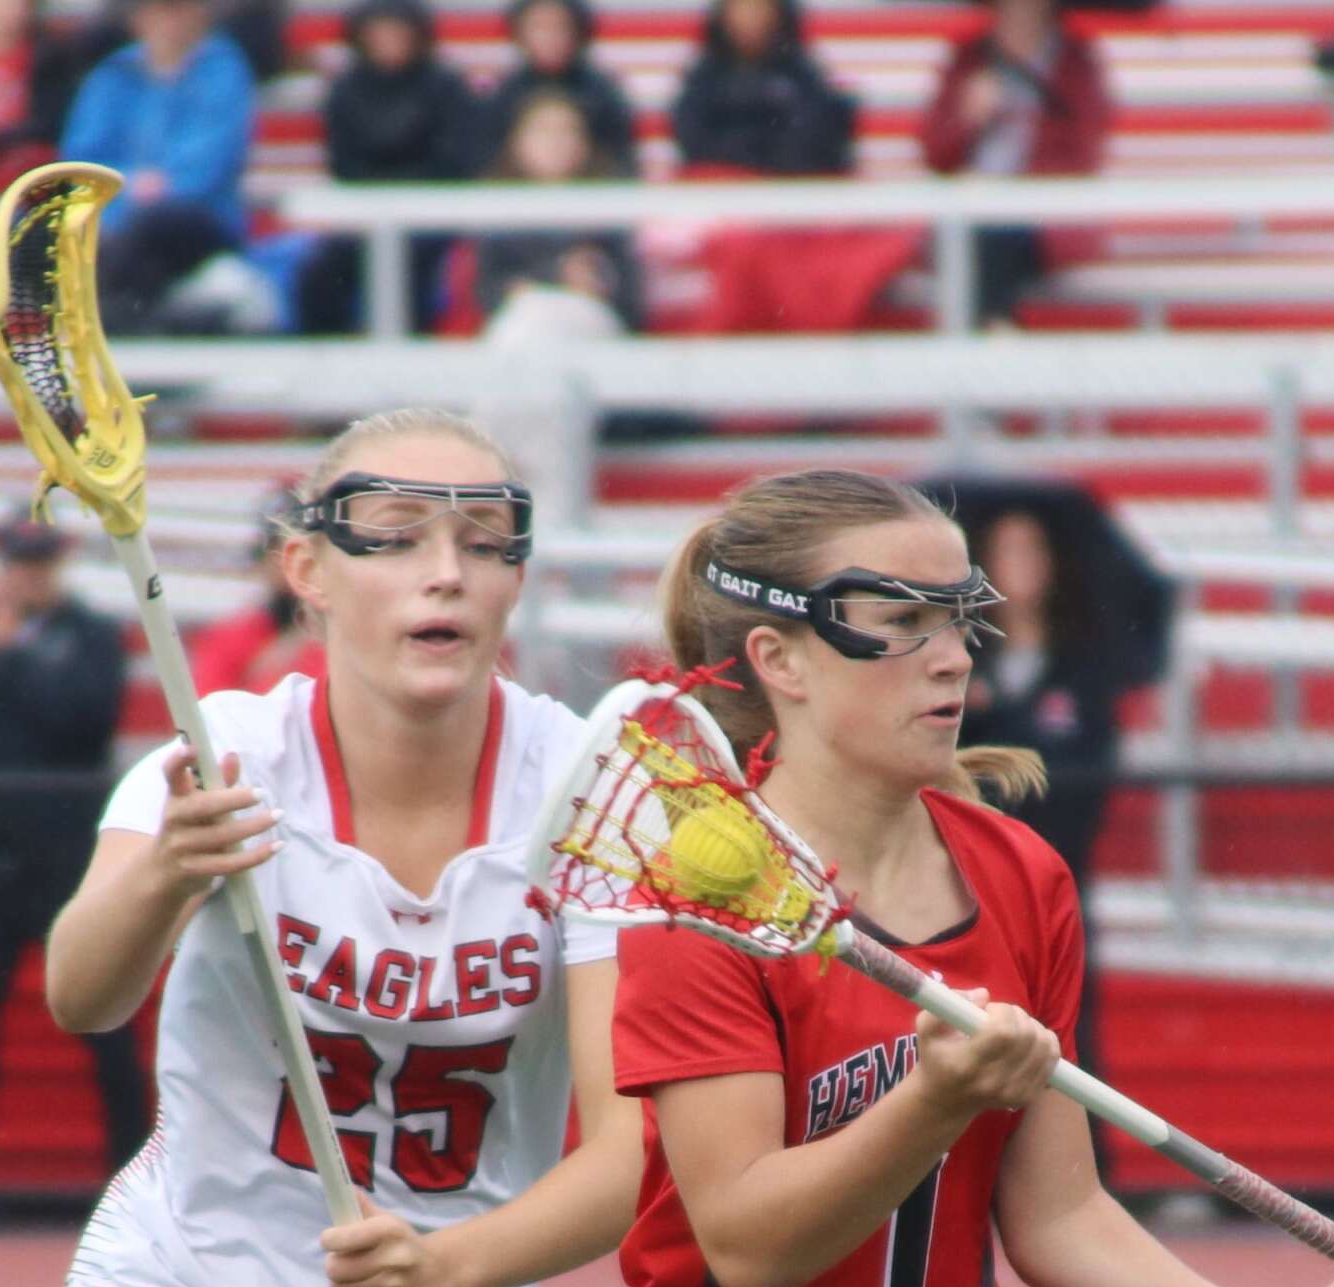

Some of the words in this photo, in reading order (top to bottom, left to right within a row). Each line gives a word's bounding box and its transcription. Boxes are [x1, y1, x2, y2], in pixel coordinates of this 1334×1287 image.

[721, 572, 762, 598] GAIT
[768, 588, 812, 612] GAI
[277, 912, 542, 1022] EAGLES
[270, 1025, 515, 1193] 25
[803, 1032, 919, 1144] HEM
